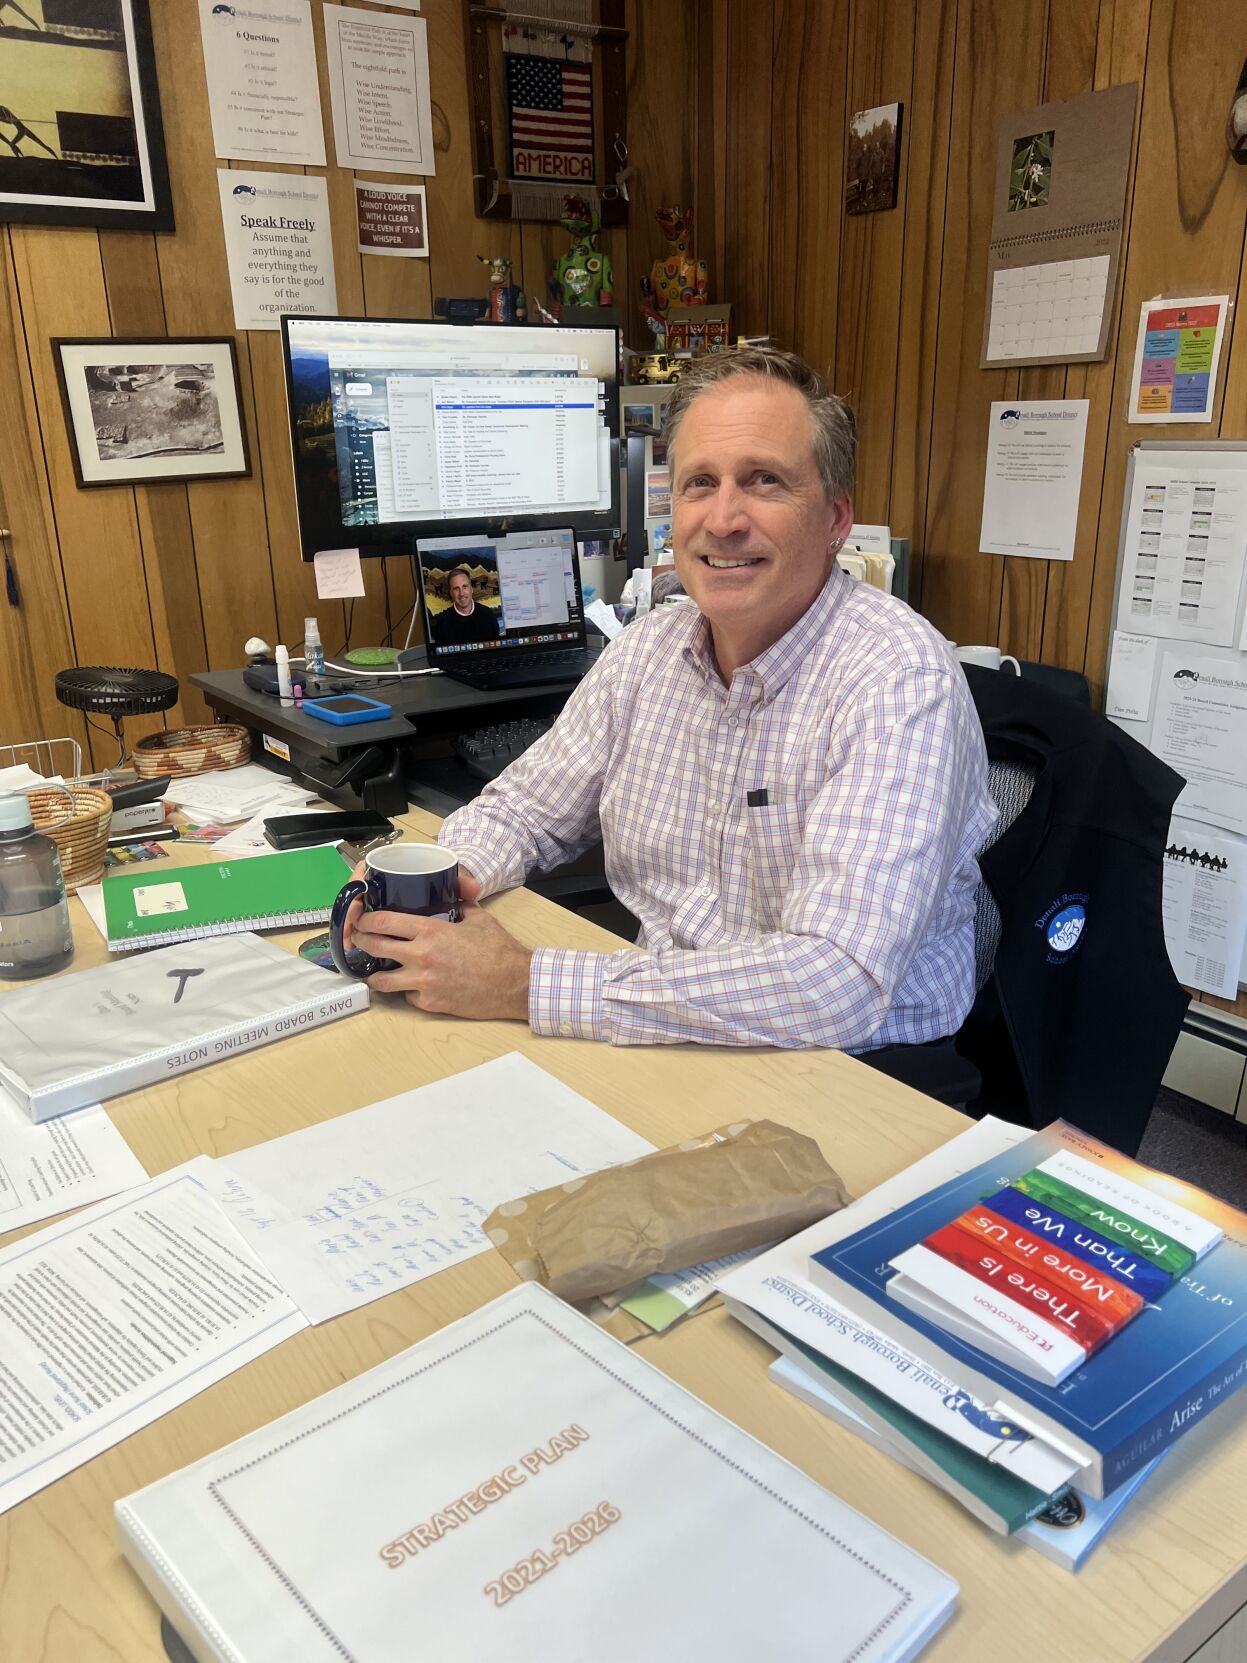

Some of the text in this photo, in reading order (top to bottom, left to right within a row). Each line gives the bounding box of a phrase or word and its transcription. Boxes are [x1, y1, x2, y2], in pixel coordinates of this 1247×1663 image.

[243, 32, 280, 43] Questions
[514, 151, 592, 178] AMERICA
[360, 200, 415, 212] CANNOT COMPETE
[387, 193, 407, 201] VOICE
[241, 214, 316, 232] Speak Freely
[366, 212, 381, 220] WITH
[377, 224, 394, 232] EVEN
[253, 232, 308, 243] Assume that
[373, 235, 403, 243] WHISPER.
[253, 247, 311, 259] anything and
[244, 274, 324, 287] say is for the good
[248, 261, 318, 274] everything they
[274, 289, 300, 298] of the
[259, 303, 318, 313] organization.
[1034, 898, 1062, 929] Denali
[166, 998, 353, 1069] DAN'S BOARD MEETING NOTES
[1024, 1208, 1137, 1280] Than We
[1090, 1210, 1168, 1257] Know
[975, 1216, 1115, 1302] More in Us
[761, 1277, 803, 1307] District
[979, 1257, 1080, 1329] There Is
[1206, 1294, 1233, 1306] of
[805, 1305, 848, 1336] School
[974, 1295, 1038, 1343] Education
[852, 1327, 910, 1373] Borough
[910, 1370, 972, 1412] Denali
[1114, 1364, 1244, 1474] AGUILAR Arise The Art of
[379, 1423, 590, 1568] STRATEGIC PLAN
[484, 1500, 622, 1608] 2021-2026
